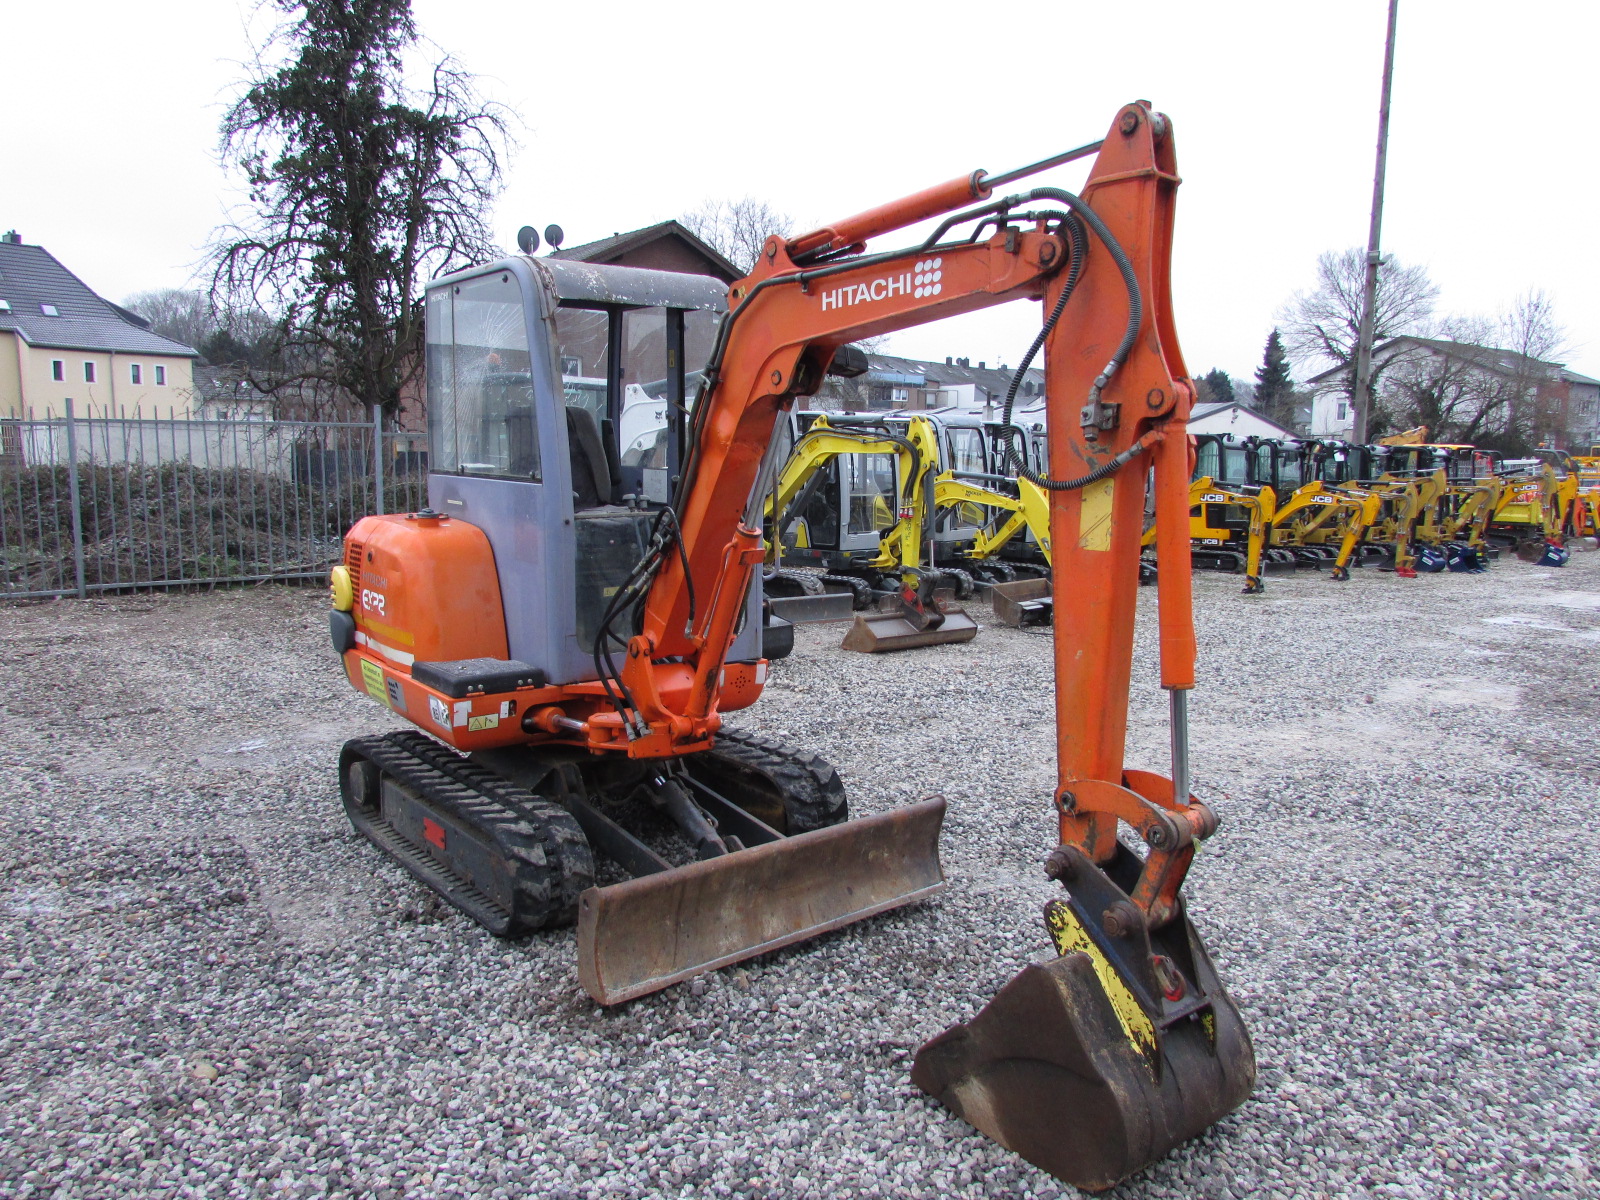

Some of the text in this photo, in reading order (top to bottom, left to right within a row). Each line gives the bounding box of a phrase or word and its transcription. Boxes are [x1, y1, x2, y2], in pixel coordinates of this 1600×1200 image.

[821, 272, 911, 311] HITACHI
[1200, 494, 1224, 502] JCB
[1310, 495, 1333, 504] JCB
[363, 571, 388, 590] HITACHI
